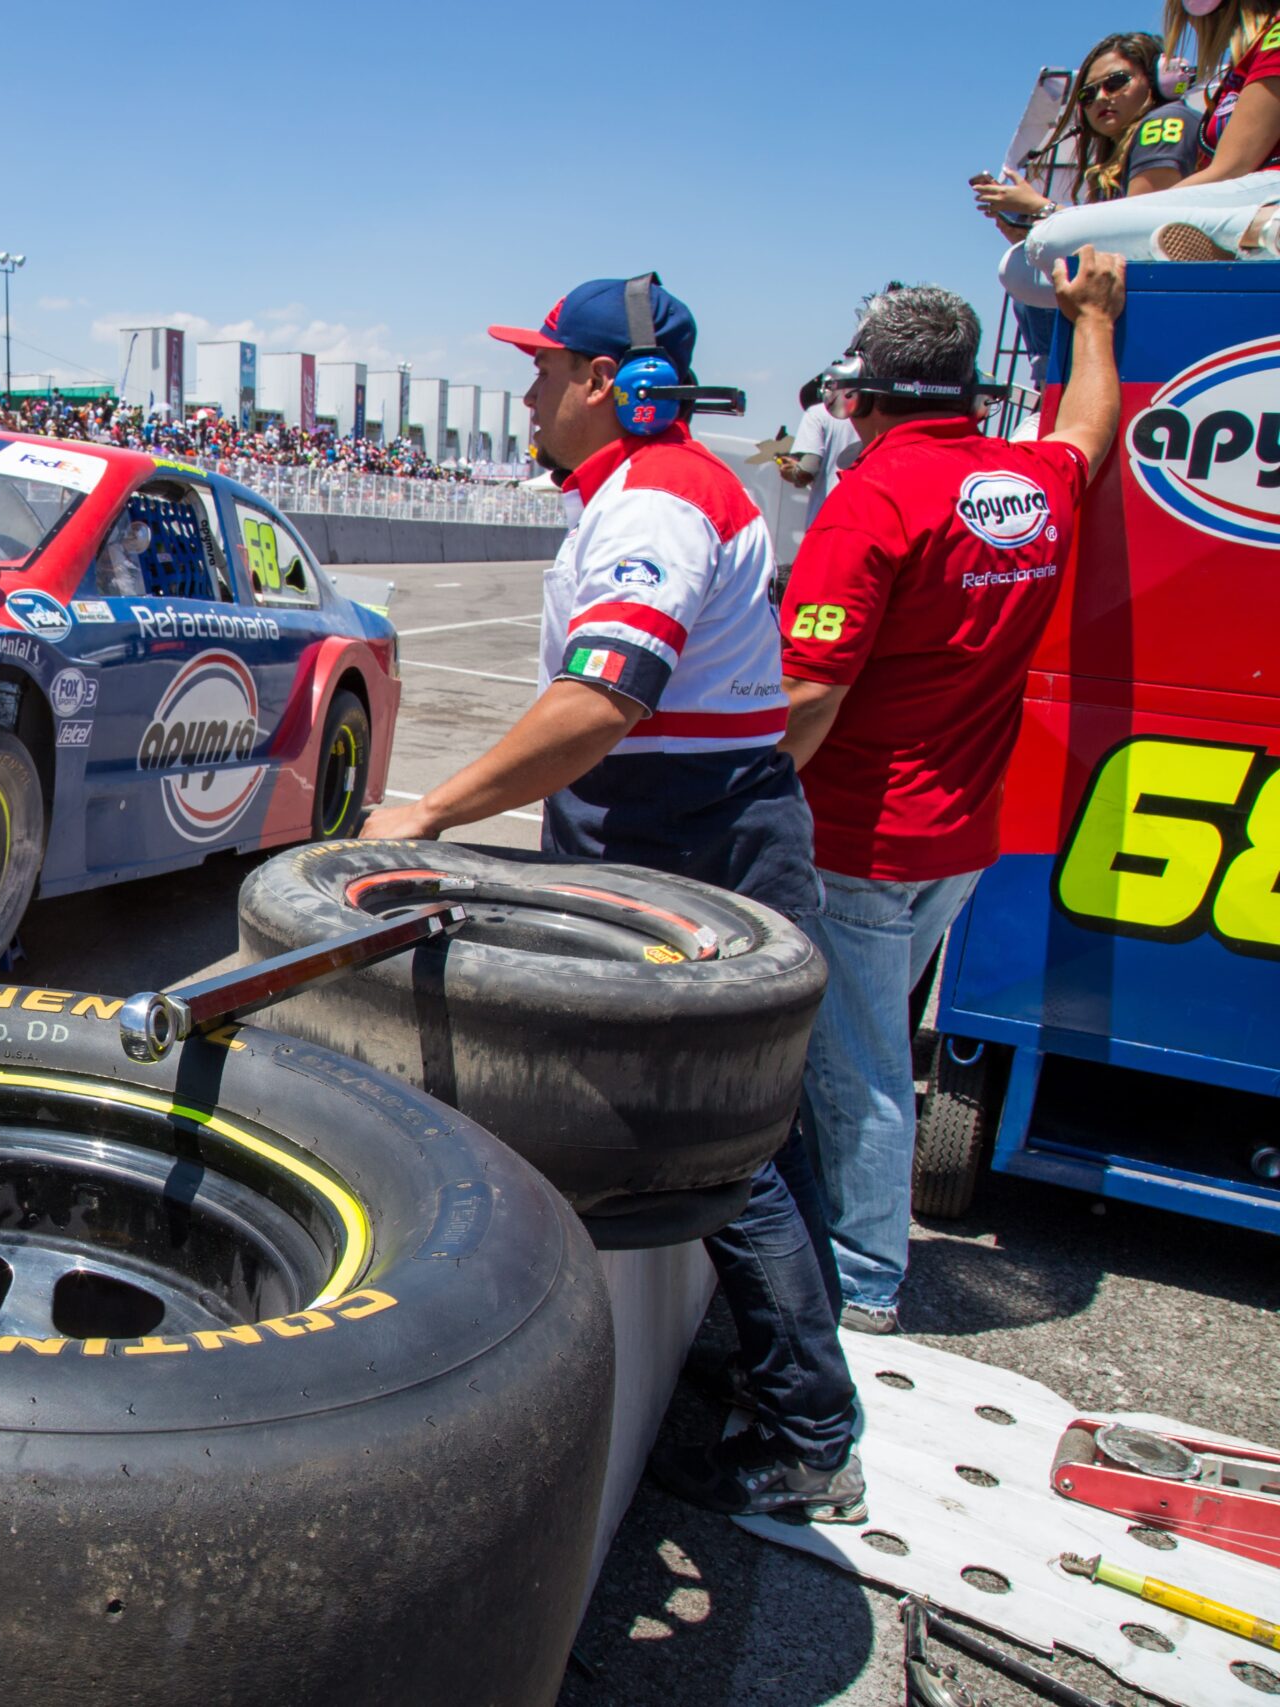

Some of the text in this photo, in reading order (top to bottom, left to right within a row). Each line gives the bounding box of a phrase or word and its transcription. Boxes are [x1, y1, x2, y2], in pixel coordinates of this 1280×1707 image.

[1140, 118, 1184, 145] 68
[633, 406, 656, 423] 33
[20, 453, 81, 474] FedEx
[959, 491, 1048, 526] apymsa
[243, 518, 281, 589] 68
[961, 562, 1057, 588] Refaccionaria
[26, 611, 68, 628] PEAK
[129, 605, 280, 640] Refaccionaria
[791, 603, 846, 641] 68
[60, 679, 80, 698] FOX
[730, 680, 754, 696] Fuel
[60, 724, 92, 744] telcel
[139, 719, 255, 791] apymsa
[27, 1020, 69, 1043] DD
[3, 1050, 40, 1062] U.S.A.
